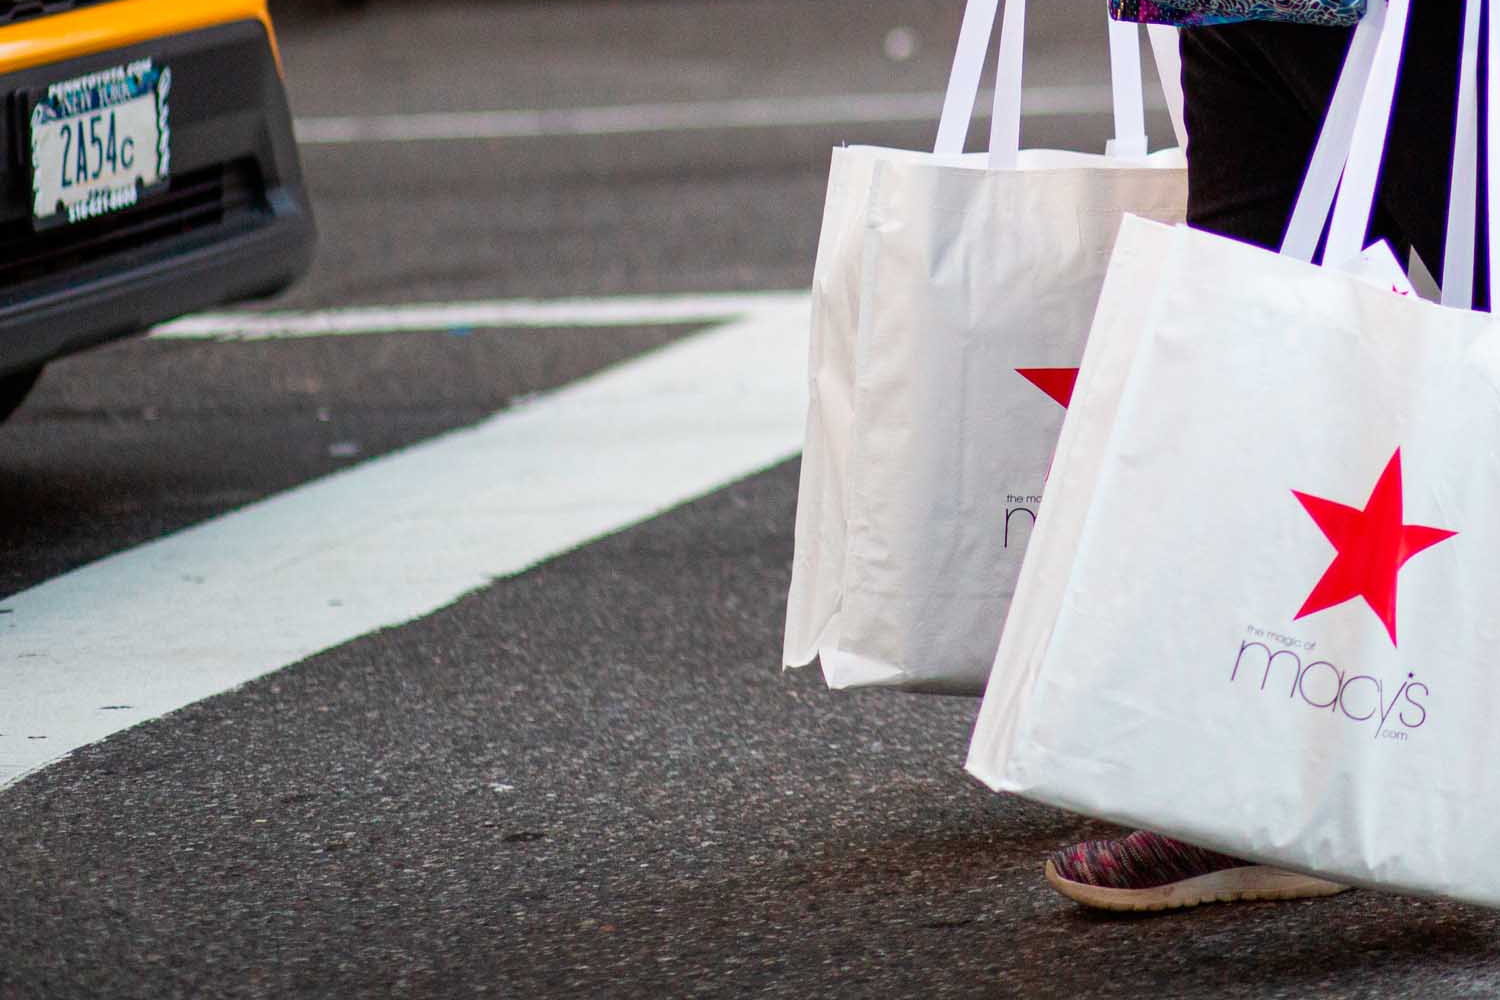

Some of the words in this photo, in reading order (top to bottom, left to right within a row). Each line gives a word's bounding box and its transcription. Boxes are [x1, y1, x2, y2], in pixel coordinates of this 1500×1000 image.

[1006, 493, 1024, 503] the
[1247, 624, 1265, 638] the
[1267, 631, 1302, 648] magic
[1303, 640, 1317, 651] of
[1230, 640, 1429, 739] macy's
